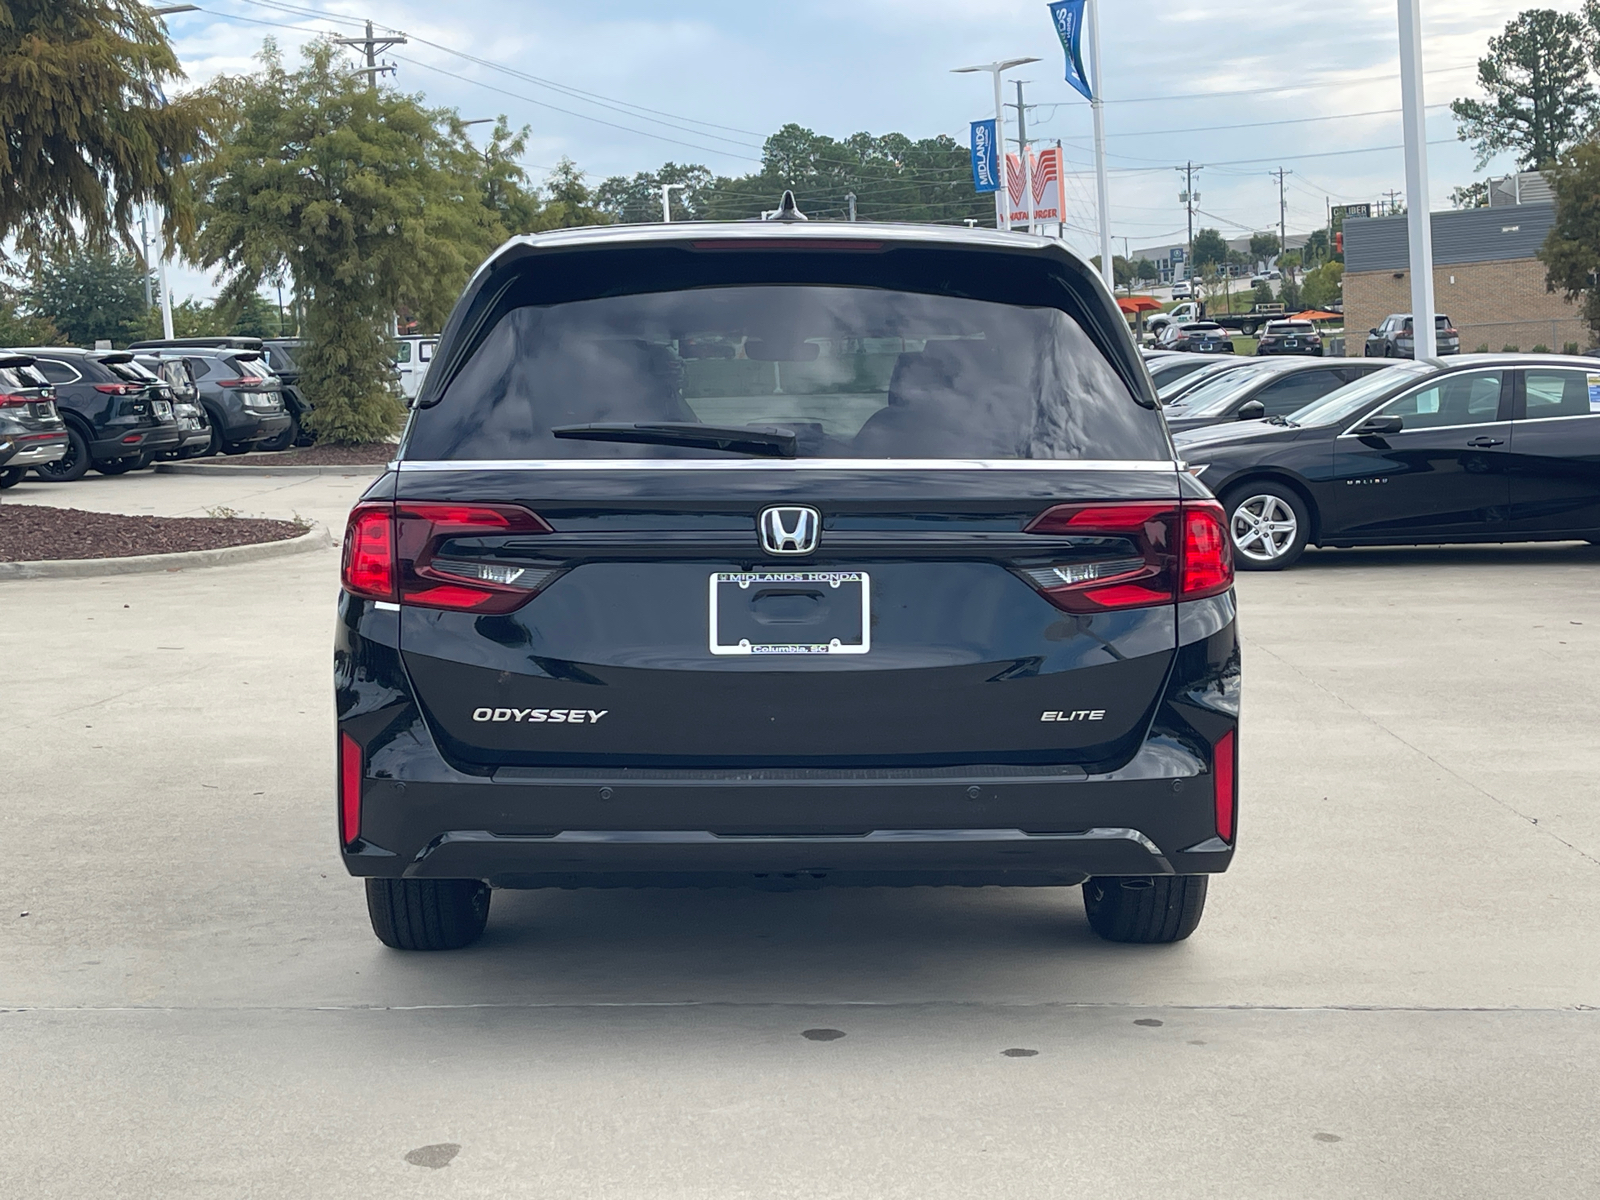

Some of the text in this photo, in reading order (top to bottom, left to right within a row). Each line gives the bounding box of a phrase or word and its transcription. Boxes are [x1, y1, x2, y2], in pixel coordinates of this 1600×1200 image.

[975, 125, 989, 186] MIDLANDS
[730, 572, 860, 581] MIDLANDS HONDA
[811, 645, 827, 653] SC
[472, 707, 609, 723] ODYSSEY
[1040, 709, 1106, 722] ELITE
